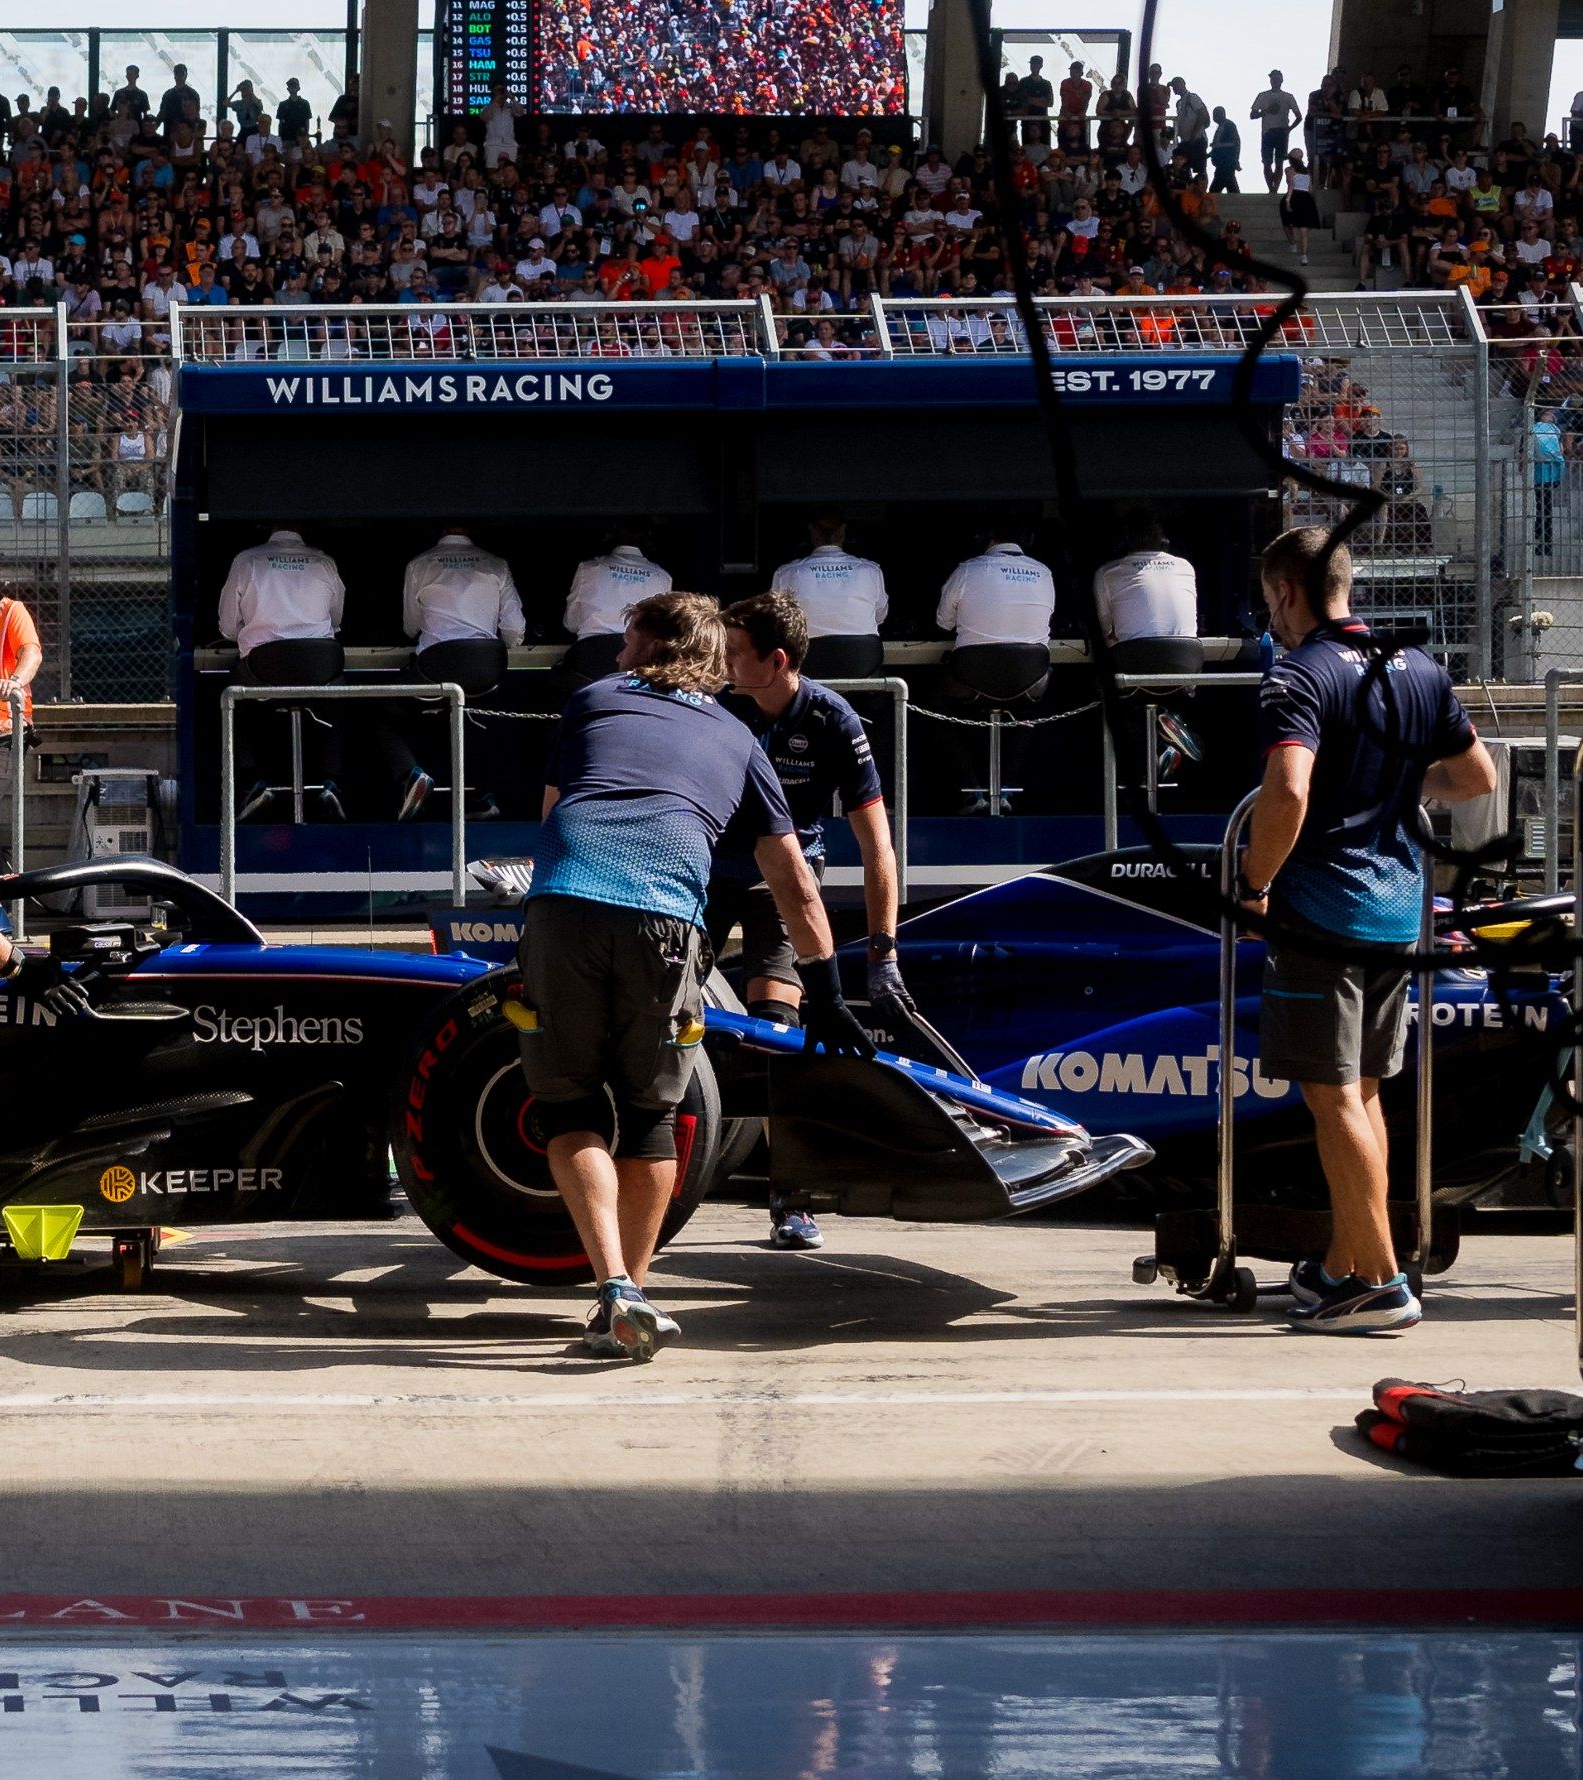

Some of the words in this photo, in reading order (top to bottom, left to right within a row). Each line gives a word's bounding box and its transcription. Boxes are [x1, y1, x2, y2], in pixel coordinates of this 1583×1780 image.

[469, 1, 495, 9] MAG
[469, 13, 491, 21] ALO
[469, 25, 491, 33] BOT
[469, 37, 491, 45] GAS
[452, 49, 463, 57] 15
[469, 48, 491, 57] TSU
[452, 61, 463, 69] 16
[469, 60, 495, 69] HAM
[469, 73, 490, 81] STR
[452, 85, 463, 93] 18
[469, 84, 491, 93] HUL
[452, 97, 463, 105] 19
[469, 96, 491, 105] SAR
[1050, 371, 1120, 391] EST.
[1129, 370, 1216, 391] 1977
[266, 376, 457, 404] WILLIAMS
[467, 374, 614, 402] RACING
[267, 556, 310, 564] WILLIAMS
[609, 565, 651, 577] WILLIAMS
[1000, 567, 1041, 578] WILLIAMS
[775, 756, 816, 768] WILLIAMS
[450, 922, 525, 943] KOM
[192, 1004, 364, 1051] Stephens
[1021, 1045, 1290, 1098] KOMATSU
[141, 1168, 283, 1195] KEEPER
